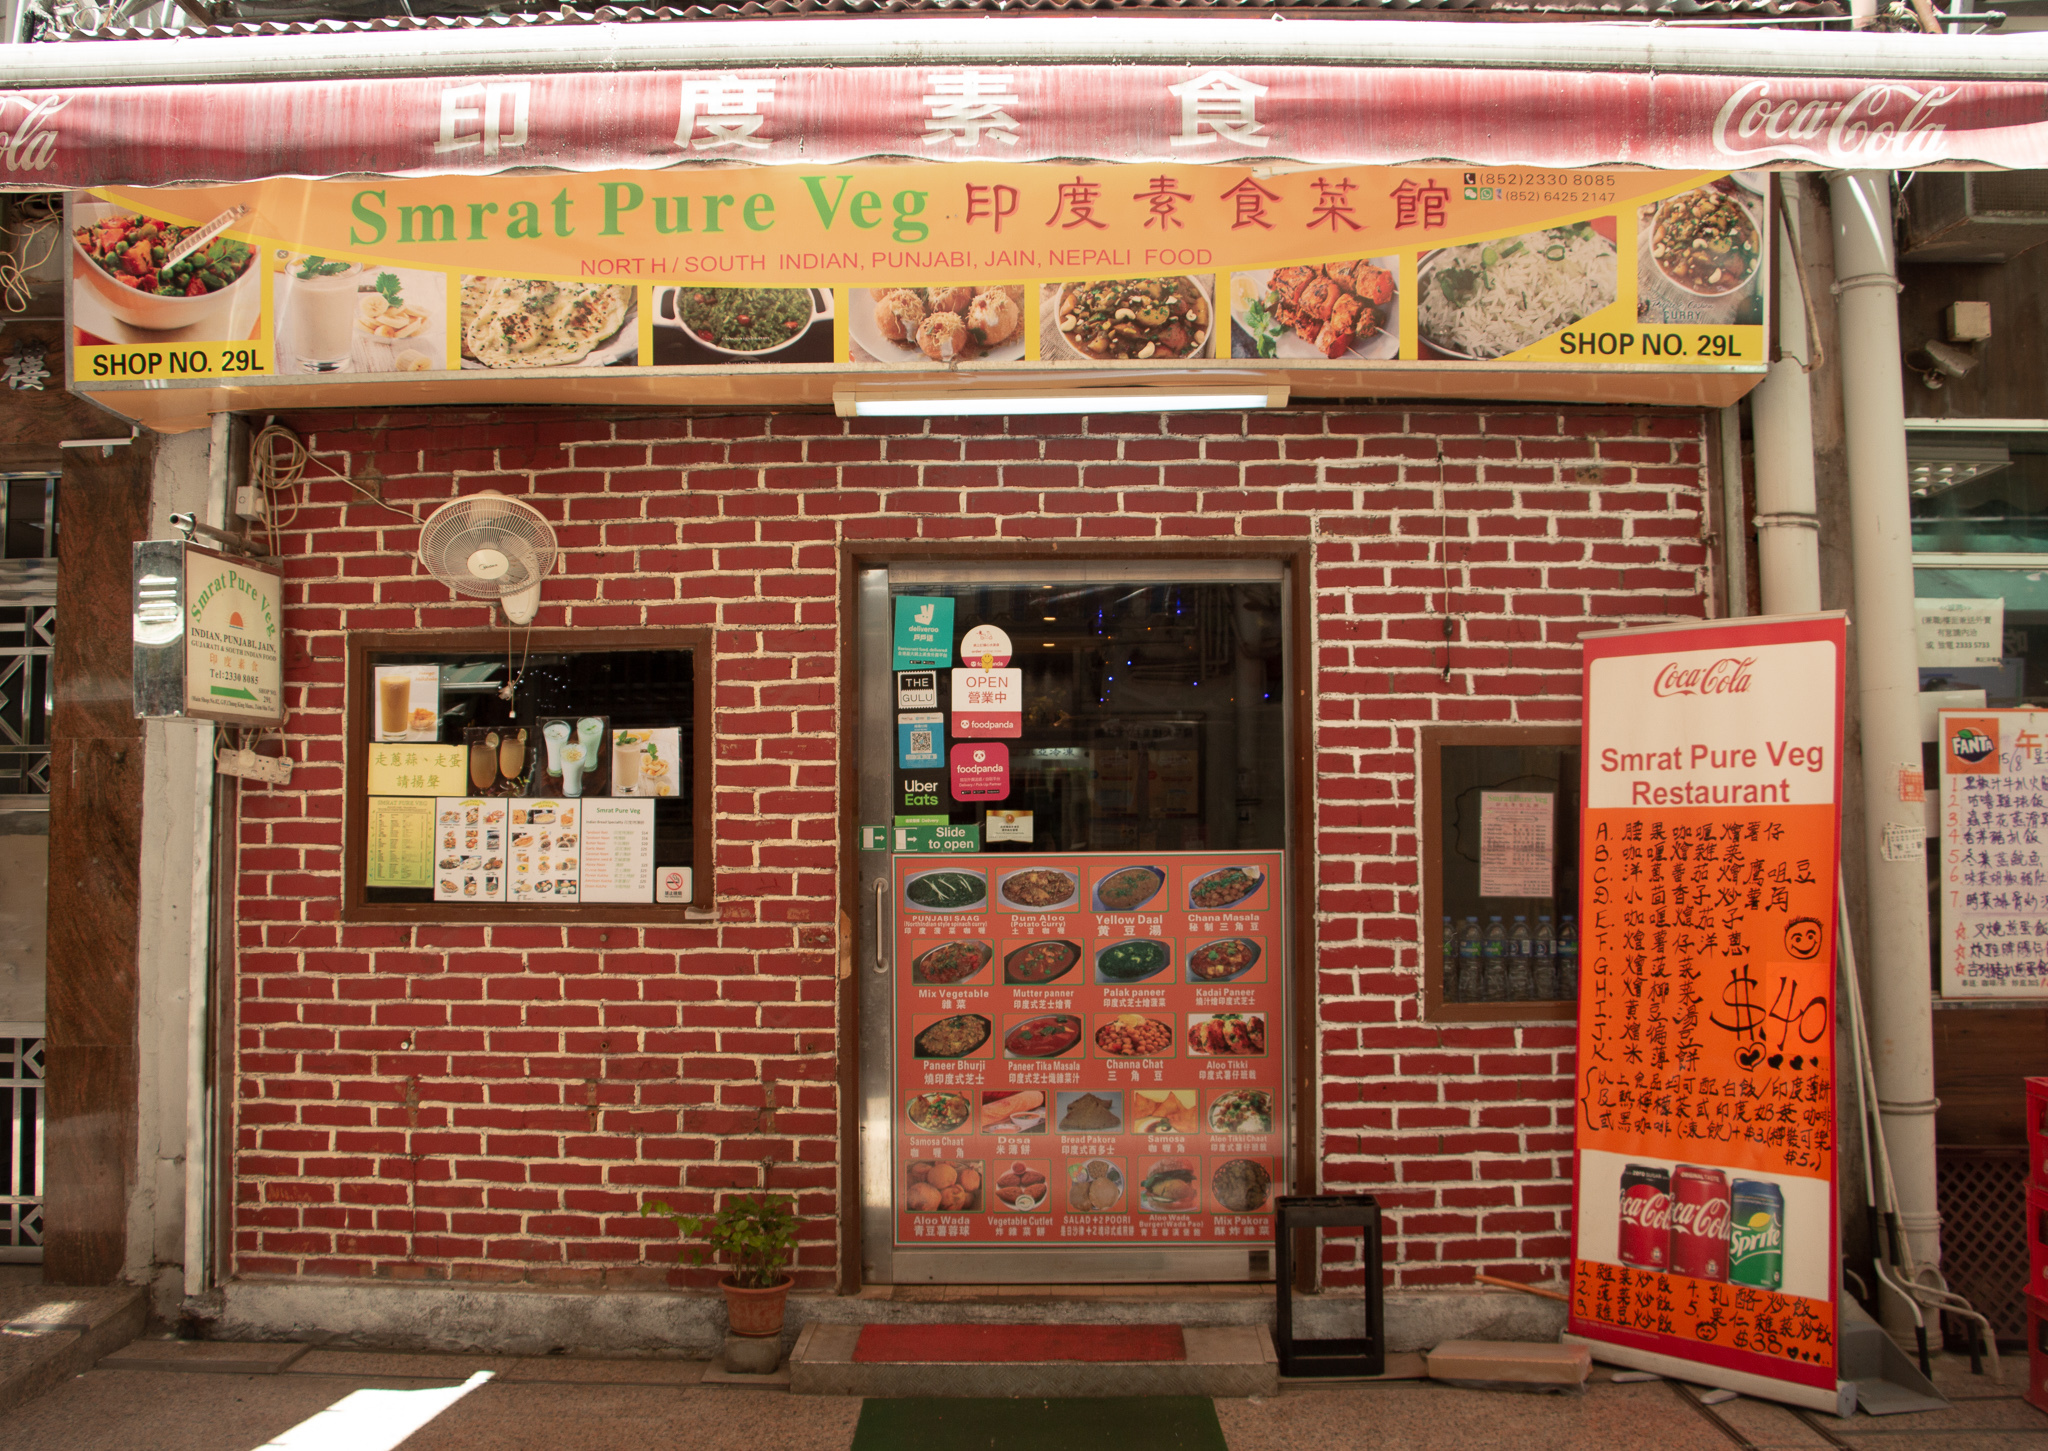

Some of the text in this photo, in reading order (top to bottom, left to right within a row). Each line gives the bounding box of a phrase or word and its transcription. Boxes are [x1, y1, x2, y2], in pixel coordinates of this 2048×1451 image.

[1712, 80, 1961, 160] Coca-Cola
[1574, 174, 1616, 187] 8085
[1505, 190, 1616, 203] (852) 6425 2147
[965, 174, 1451, 233] 印度素食菜館
[349, 175, 930, 246] Smrat Pure Veg
[685, 254, 766, 272] SOUTH
[779, 252, 864, 271] INDIAN,
[871, 251, 978, 269] PUNJABI,
[985, 249, 1041, 268] JAIN,
[1049, 249, 1131, 267] NEPALI
[1145, 248, 1213, 266] FOOD
[1664, 310, 1701, 320] CURRY
[1559, 332, 1742, 356] SHOP NO. 29L
[93, 349, 264, 376] SHOP NO. 29L
[191, 570, 276, 641] Smrat Pure Veg
[908, 625, 939, 633] deliveroo
[191, 627, 222, 642] INDIAN,
[258, 641, 276, 654] JAIN,
[191, 640, 276, 662] GUJARATI SOUTH INDIAN FOOD
[243, 674, 259, 685] 8085
[905, 677, 929, 687] THE
[966, 676, 1008, 688] OPEN
[1653, 656, 1758, 698] Coca-Cola
[902, 694, 932, 703] GULU
[968, 691, 1007, 704] 營業中
[972, 720, 1014, 730] foodpanda
[1951, 735, 1995, 755] FANTA
[1600, 741, 1823, 773] Smrat Pure Veg
[956, 764, 1004, 775] foodpanda
[396, 774, 440, 789] 請揚聲
[904, 780, 938, 792] Uber
[1632, 778, 1790, 805] Restaurant
[905, 793, 938, 806] Eats
[936, 827, 965, 837] Slide
[928, 839, 974, 851] to open
[1096, 914, 1163, 925] Yellow Daal
[1188, 913, 1260, 922] Chana Masala
[918, 989, 989, 999] Mix Vegetable
[1013, 989, 1074, 999] Mutter panner
[1103, 988, 1165, 998] Palak paneer
[1196, 988, 1255, 996] Kadai Paneer
[923, 1060, 986, 1072] Paneer Bhurji
[1008, 1061, 1080, 1071] Paneer Tika Masala
[1106, 1059, 1164, 1069] Channa Chat
[1206, 1060, 1248, 1069] Aloo Tikki
[1107, 1070, 1163, 1081] 三角豆
[910, 1137, 964, 1146] Samosa Chaat
[997, 1136, 1031, 1144] Dosa
[1061, 1135, 1116, 1144] Bread Pakora
[1147, 1135, 1185, 1143] Samosa
[1210, 1135, 1226, 1143] Aloo
[1227, 1135, 1245, 1143] Tikki
[1680, 1172, 1704, 1180] ORIGINAL
[914, 1216, 971, 1225] Aloo Wada
[988, 1216, 1053, 1227] Vegetable Cutlet
[1063, 1216, 1131, 1224] SALAD POORI
[1214, 1216, 1269, 1225] Mix Pakora
[1730, 1222, 1781, 1258] Sprite
[1733, 1329, 1783, 1354] $38
